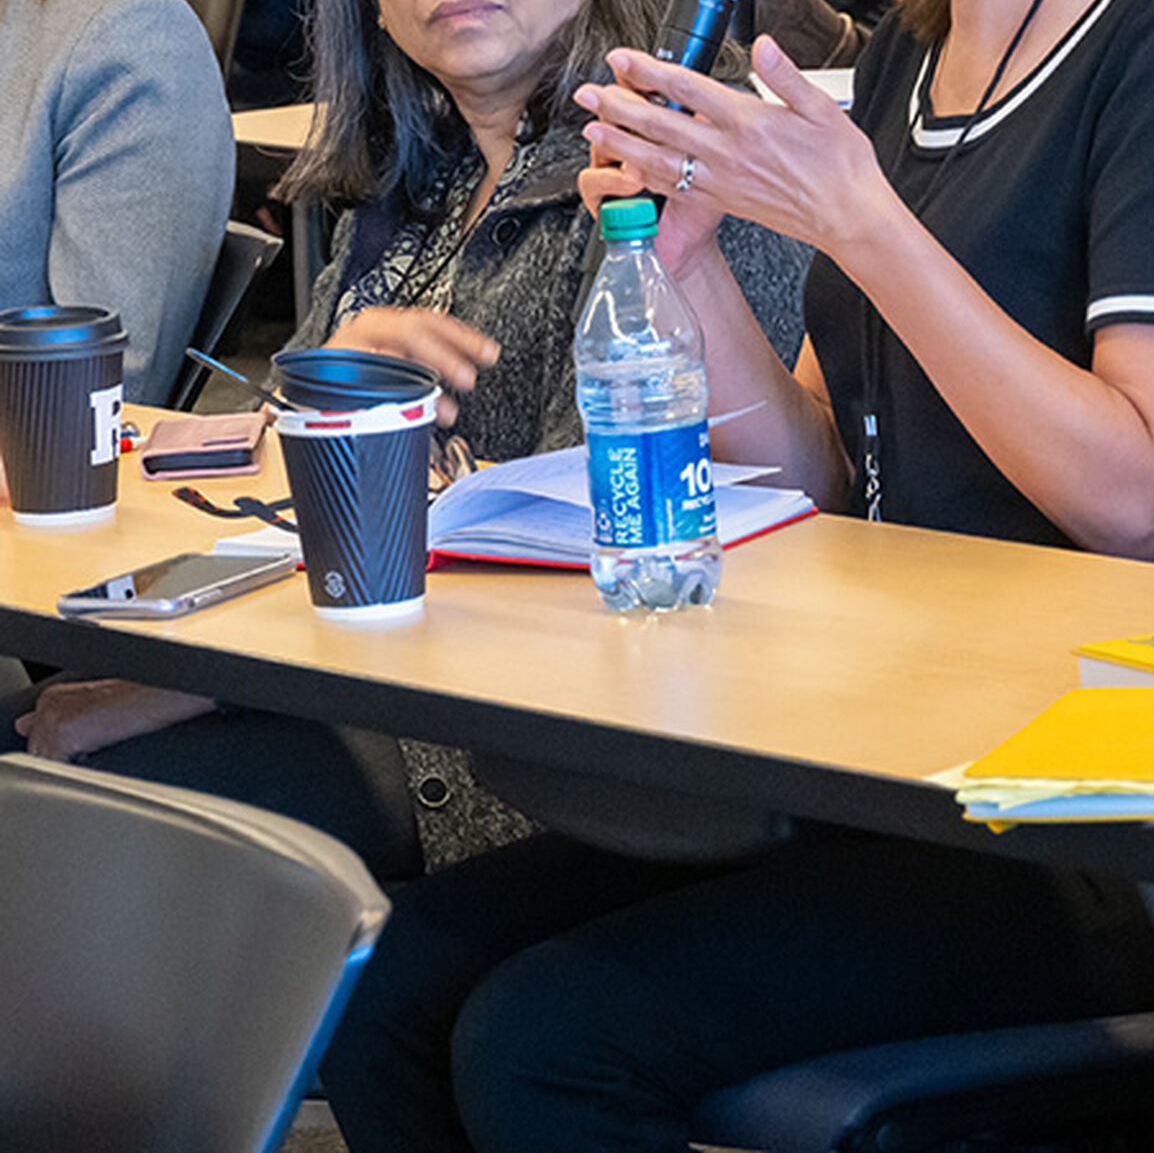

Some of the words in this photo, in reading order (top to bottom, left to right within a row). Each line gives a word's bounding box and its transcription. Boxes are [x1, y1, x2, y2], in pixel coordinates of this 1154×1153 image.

[607, 448, 628, 544] RECYCLE
[622, 447, 641, 510] AGAIN
[626, 513, 643, 544] ME
